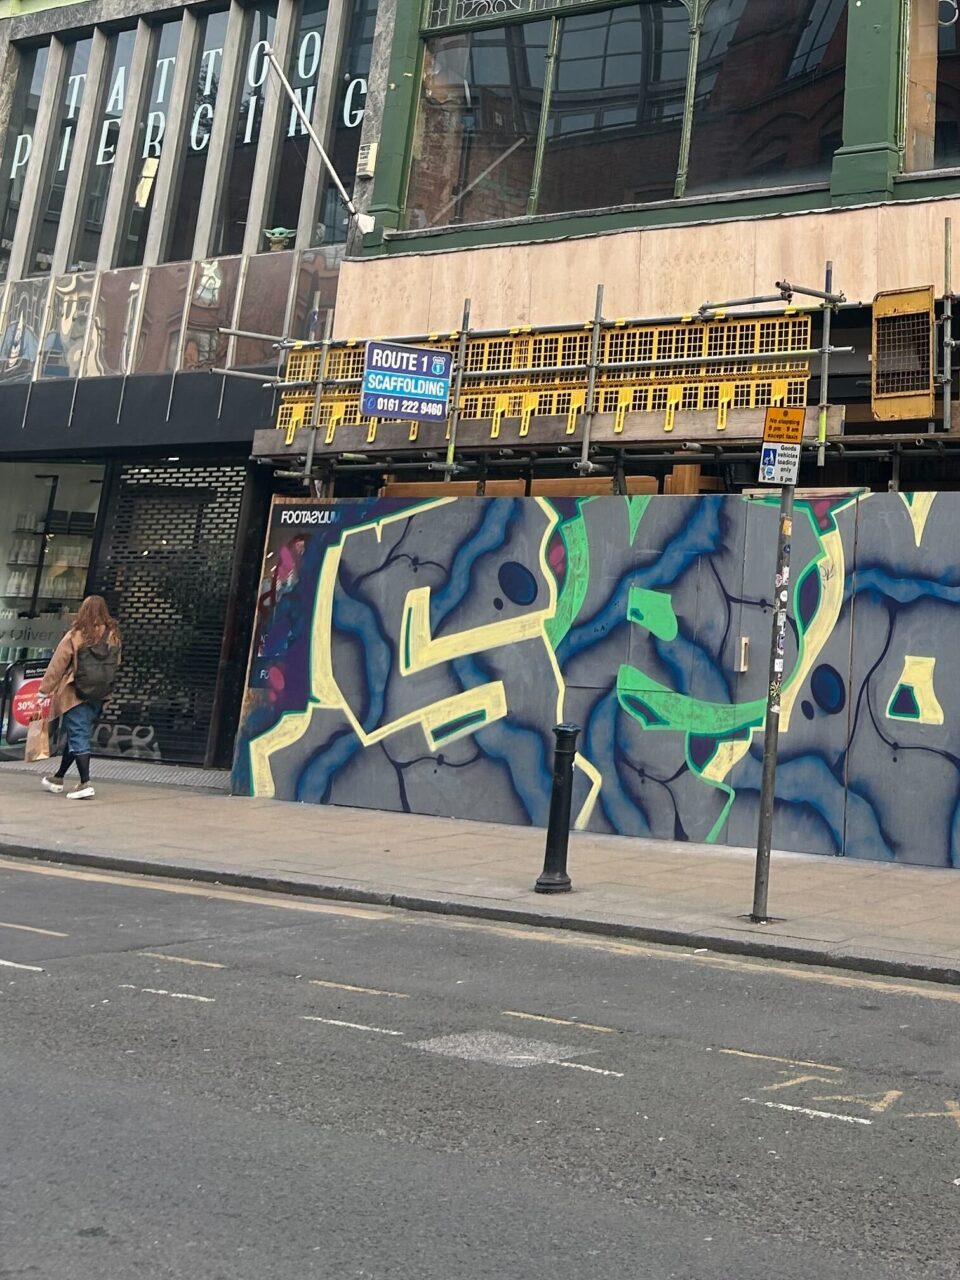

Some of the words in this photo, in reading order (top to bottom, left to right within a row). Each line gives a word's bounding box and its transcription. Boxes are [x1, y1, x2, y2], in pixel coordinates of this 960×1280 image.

[68, 30, 322, 119] TATTOO
[9, 77, 368, 180] PIERCING
[372, 348, 418, 371] ROUTE
[421, 355, 428, 372] 1
[367, 373, 444, 396] SCAFFOLDING
[377, 397, 399, 412] 0161
[401, 400, 419, 413] 222
